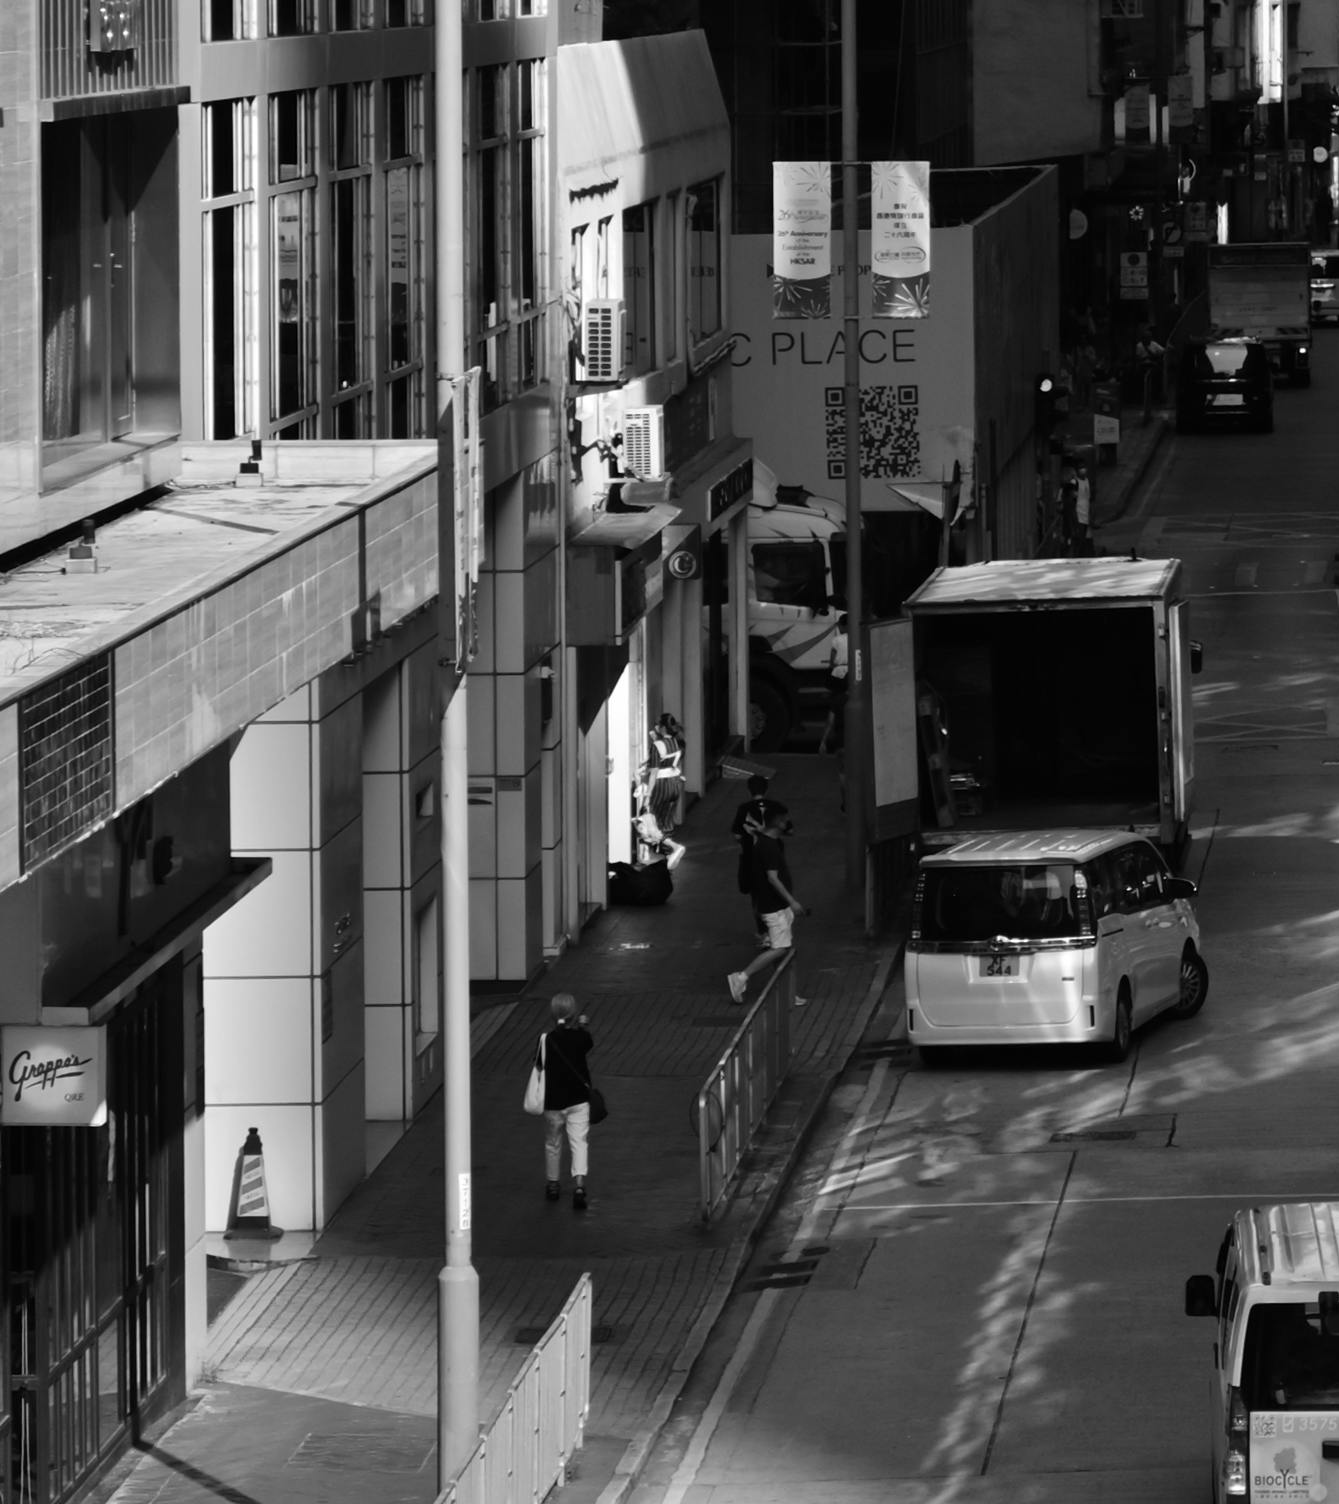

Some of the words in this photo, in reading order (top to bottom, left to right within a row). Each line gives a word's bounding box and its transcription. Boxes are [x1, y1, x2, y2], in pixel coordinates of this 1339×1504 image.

[771, 328, 916, 366] PLACE
[8, 1050, 93, 1102] Grappa's
[1299, 1417, 1338, 1431] 3575
[1254, 1469, 1310, 1489] BIOCYCLE
